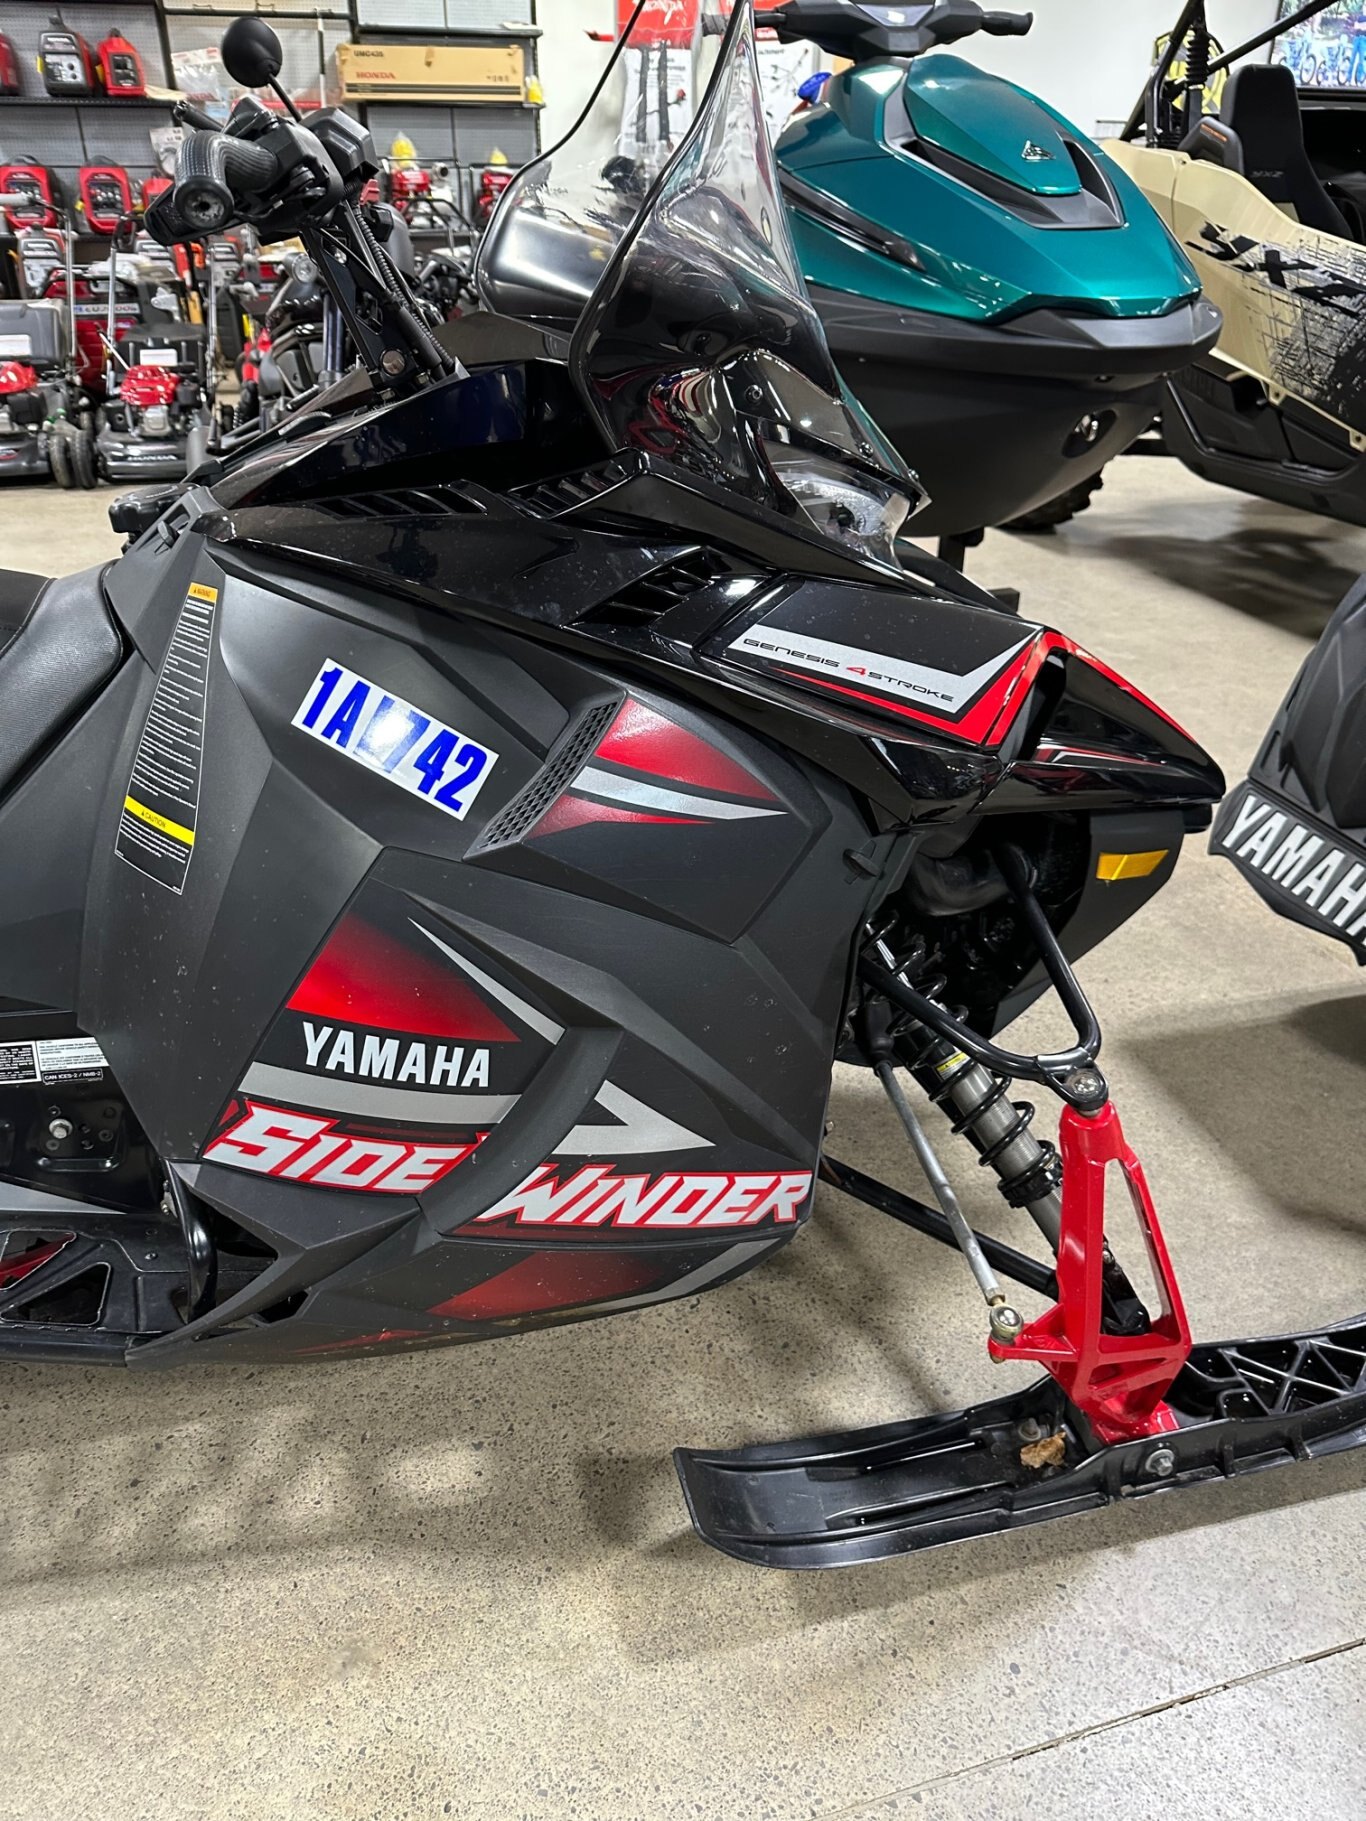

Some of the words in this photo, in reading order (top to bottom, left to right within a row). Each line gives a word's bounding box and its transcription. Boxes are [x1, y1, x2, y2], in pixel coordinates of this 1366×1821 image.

[743, 638, 840, 668] GENESIS
[1221, 795, 1366, 946] YAMAH
[302, 1020, 491, 1089] YAMAHA
